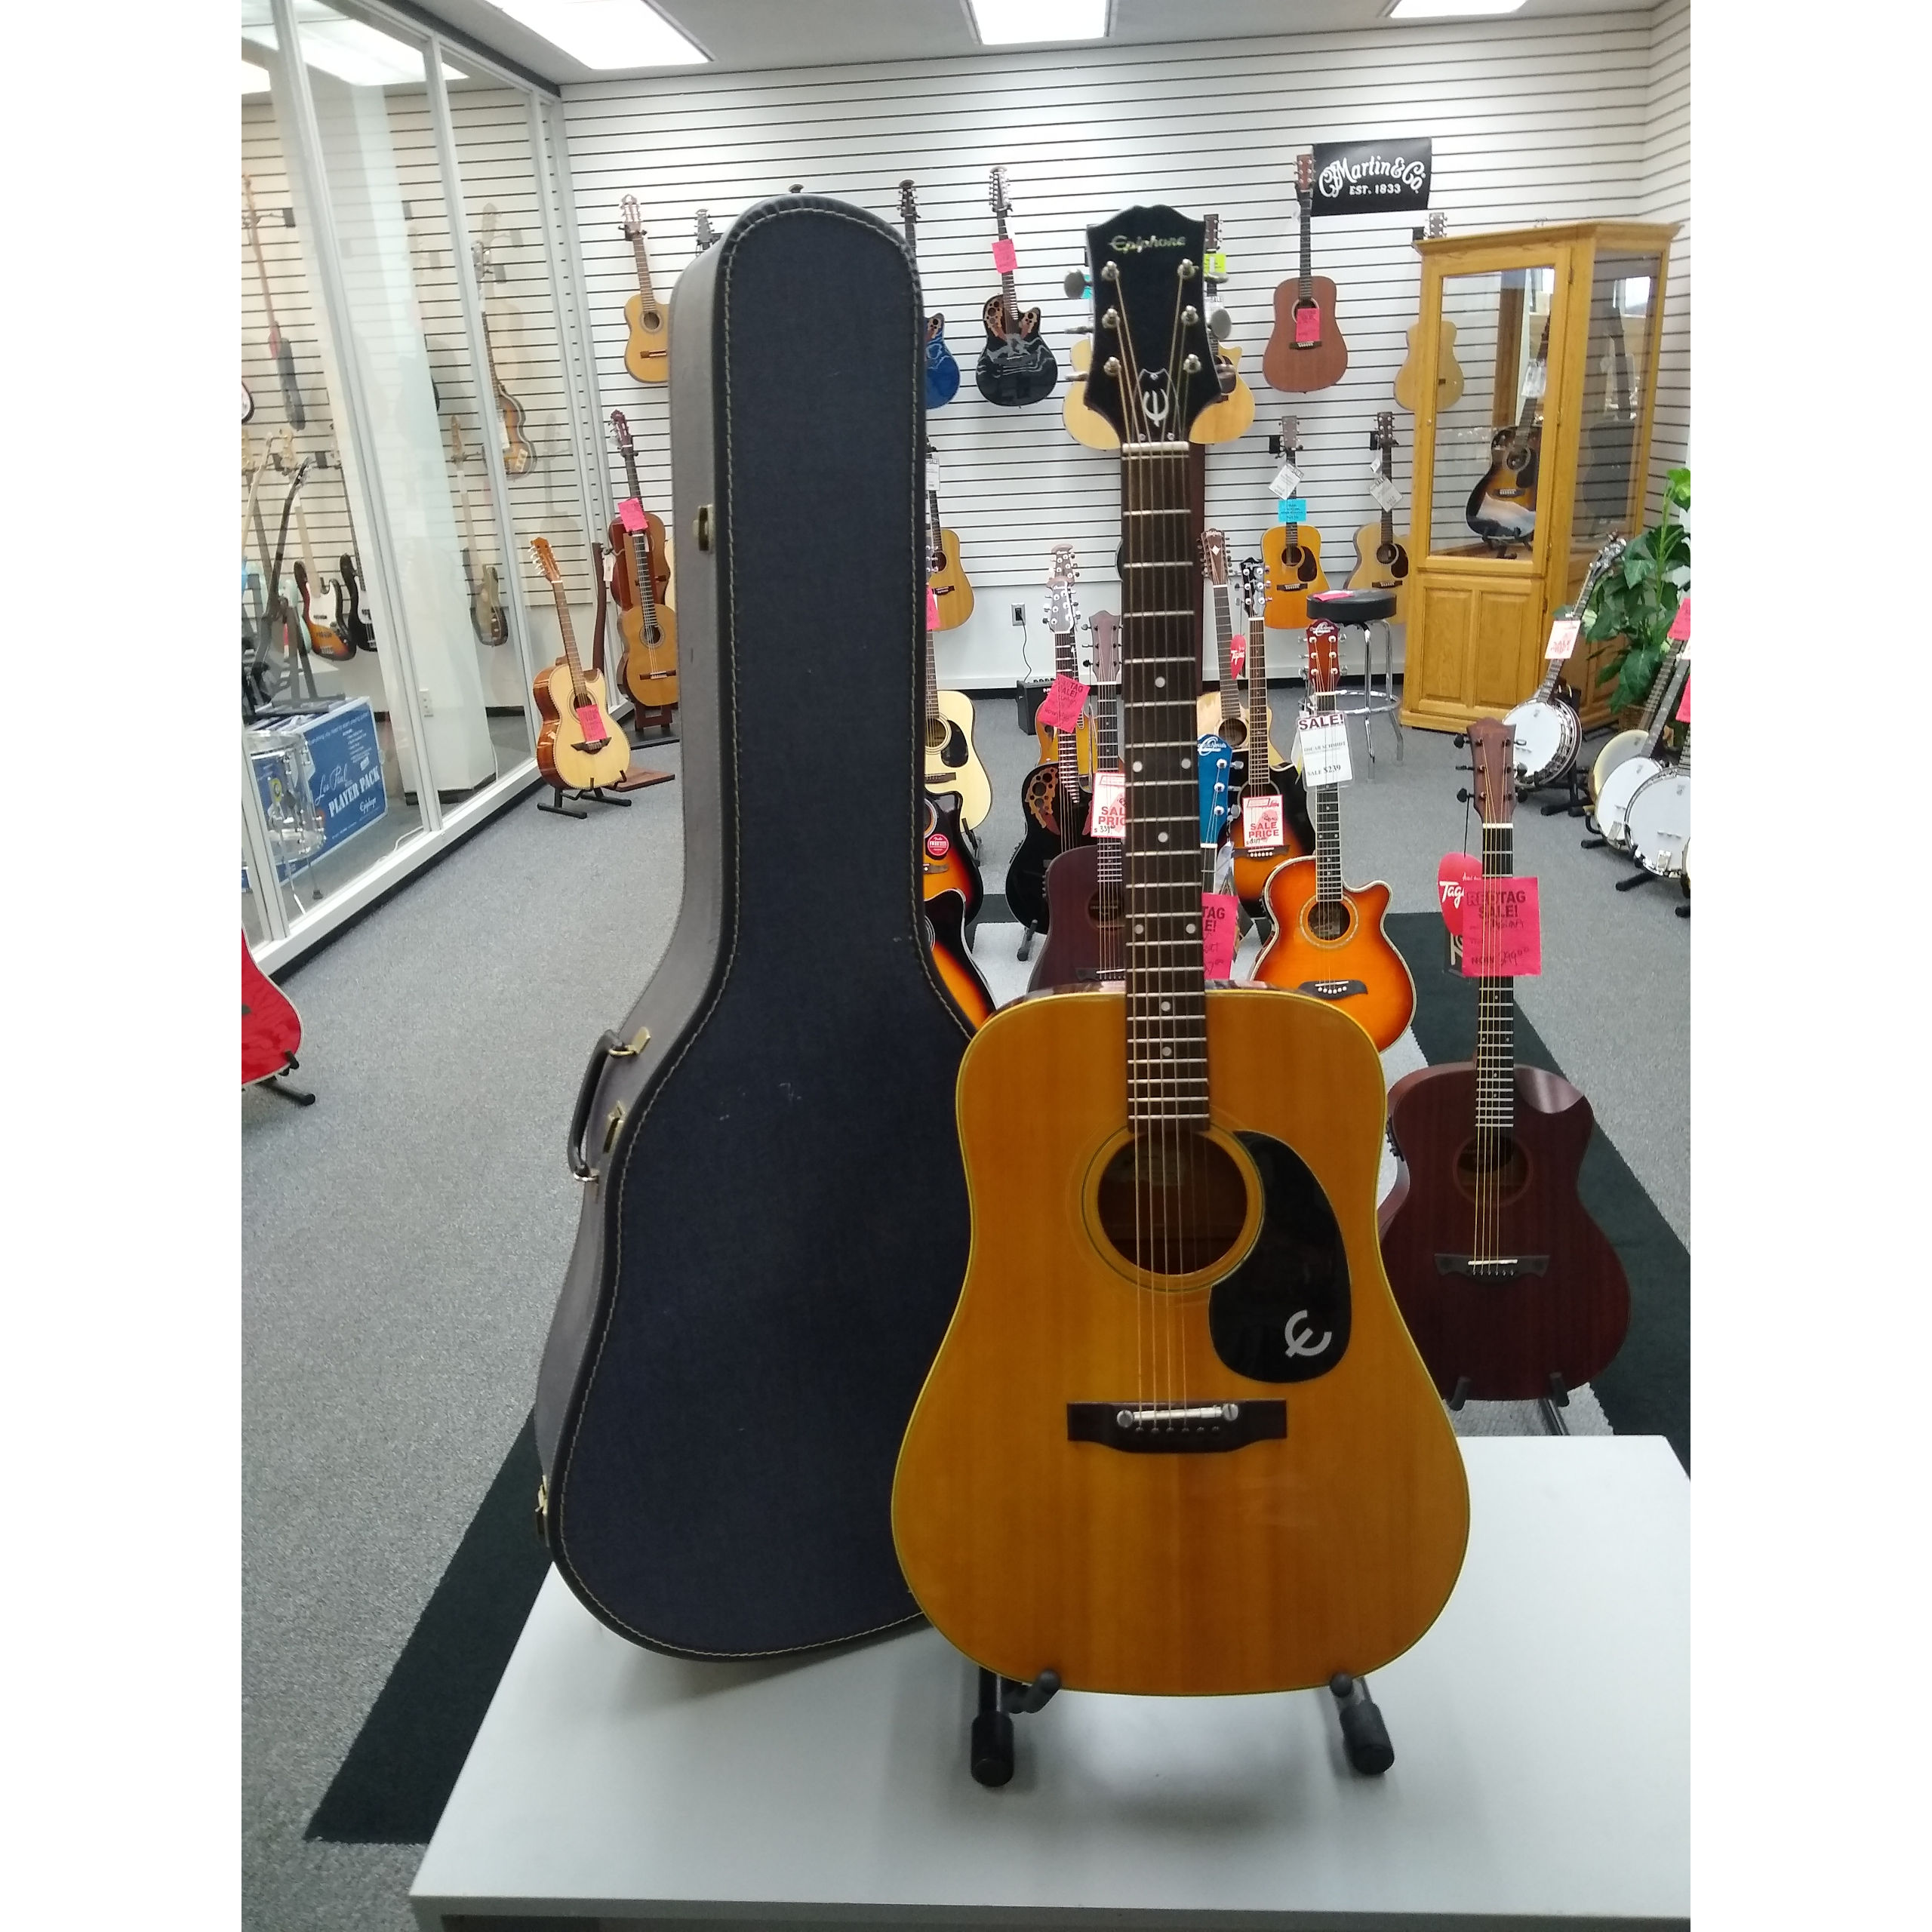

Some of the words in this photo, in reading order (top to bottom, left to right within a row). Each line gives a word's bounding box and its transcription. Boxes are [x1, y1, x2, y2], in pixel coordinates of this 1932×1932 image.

[1349, 185, 1371, 195] EST.
[1374, 183, 1401, 195] 1833
[1299, 714, 1344, 731] SALE!
[328, 783, 360, 817] PLAYER
[359, 764, 380, 793] PACK
[1101, 806, 1125, 816] SAL
[1250, 821, 1277, 831] SALE
[1248, 829, 1279, 838] PRICE
[1478, 905, 1518, 919] SALE!
